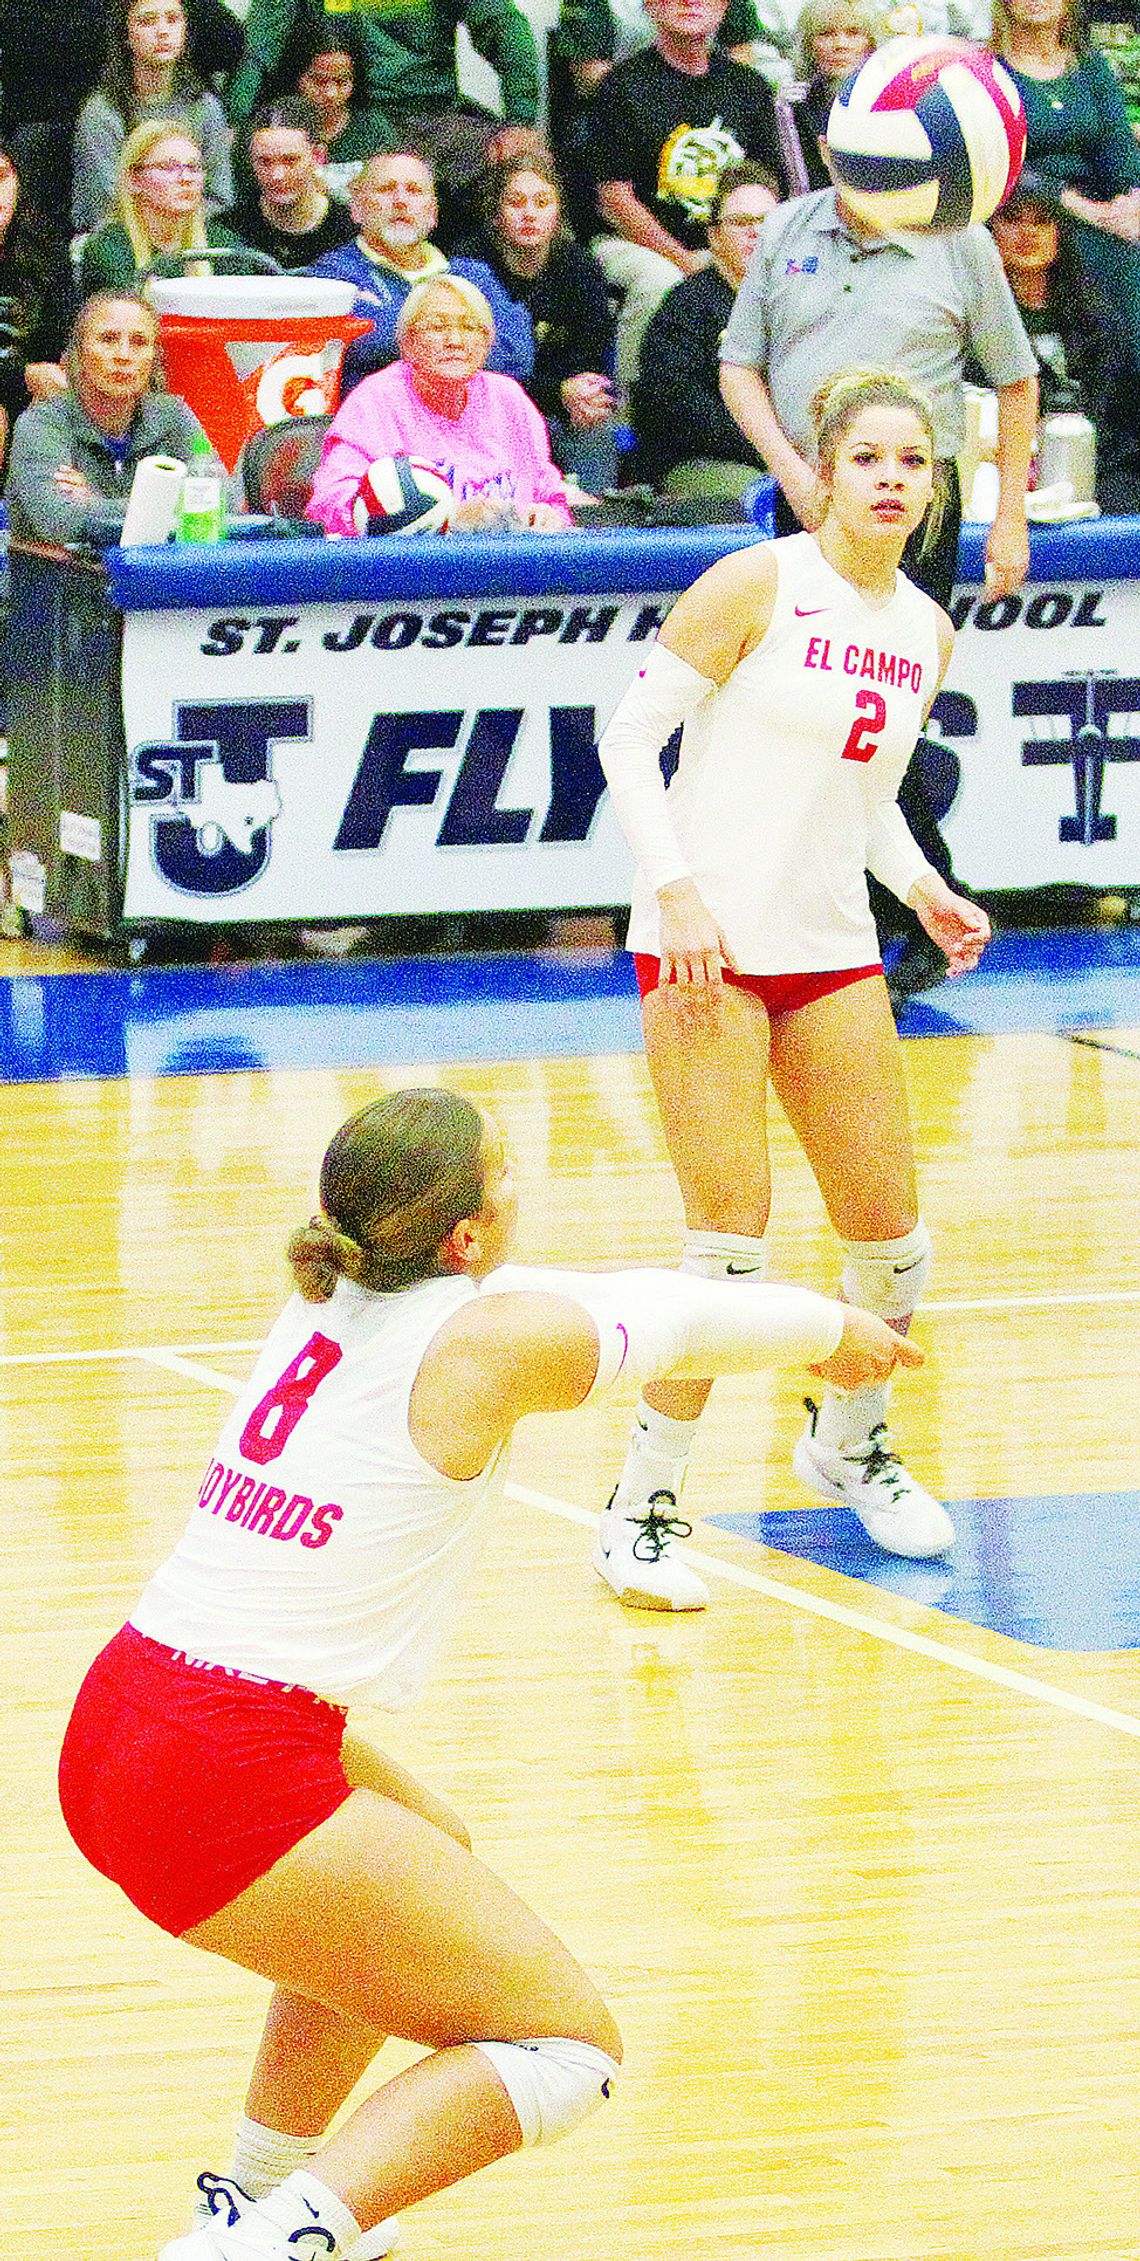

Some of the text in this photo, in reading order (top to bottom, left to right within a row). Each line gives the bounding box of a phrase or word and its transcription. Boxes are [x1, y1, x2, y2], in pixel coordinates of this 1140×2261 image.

[200, 617, 299, 656] ST.
[322, 606, 619, 651] JOSEPH
[804, 636, 923, 694] EL CAMPO
[840, 689, 887, 763] 2
[132, 741, 220, 804] ST
[239, 1331, 343, 1466] 8
